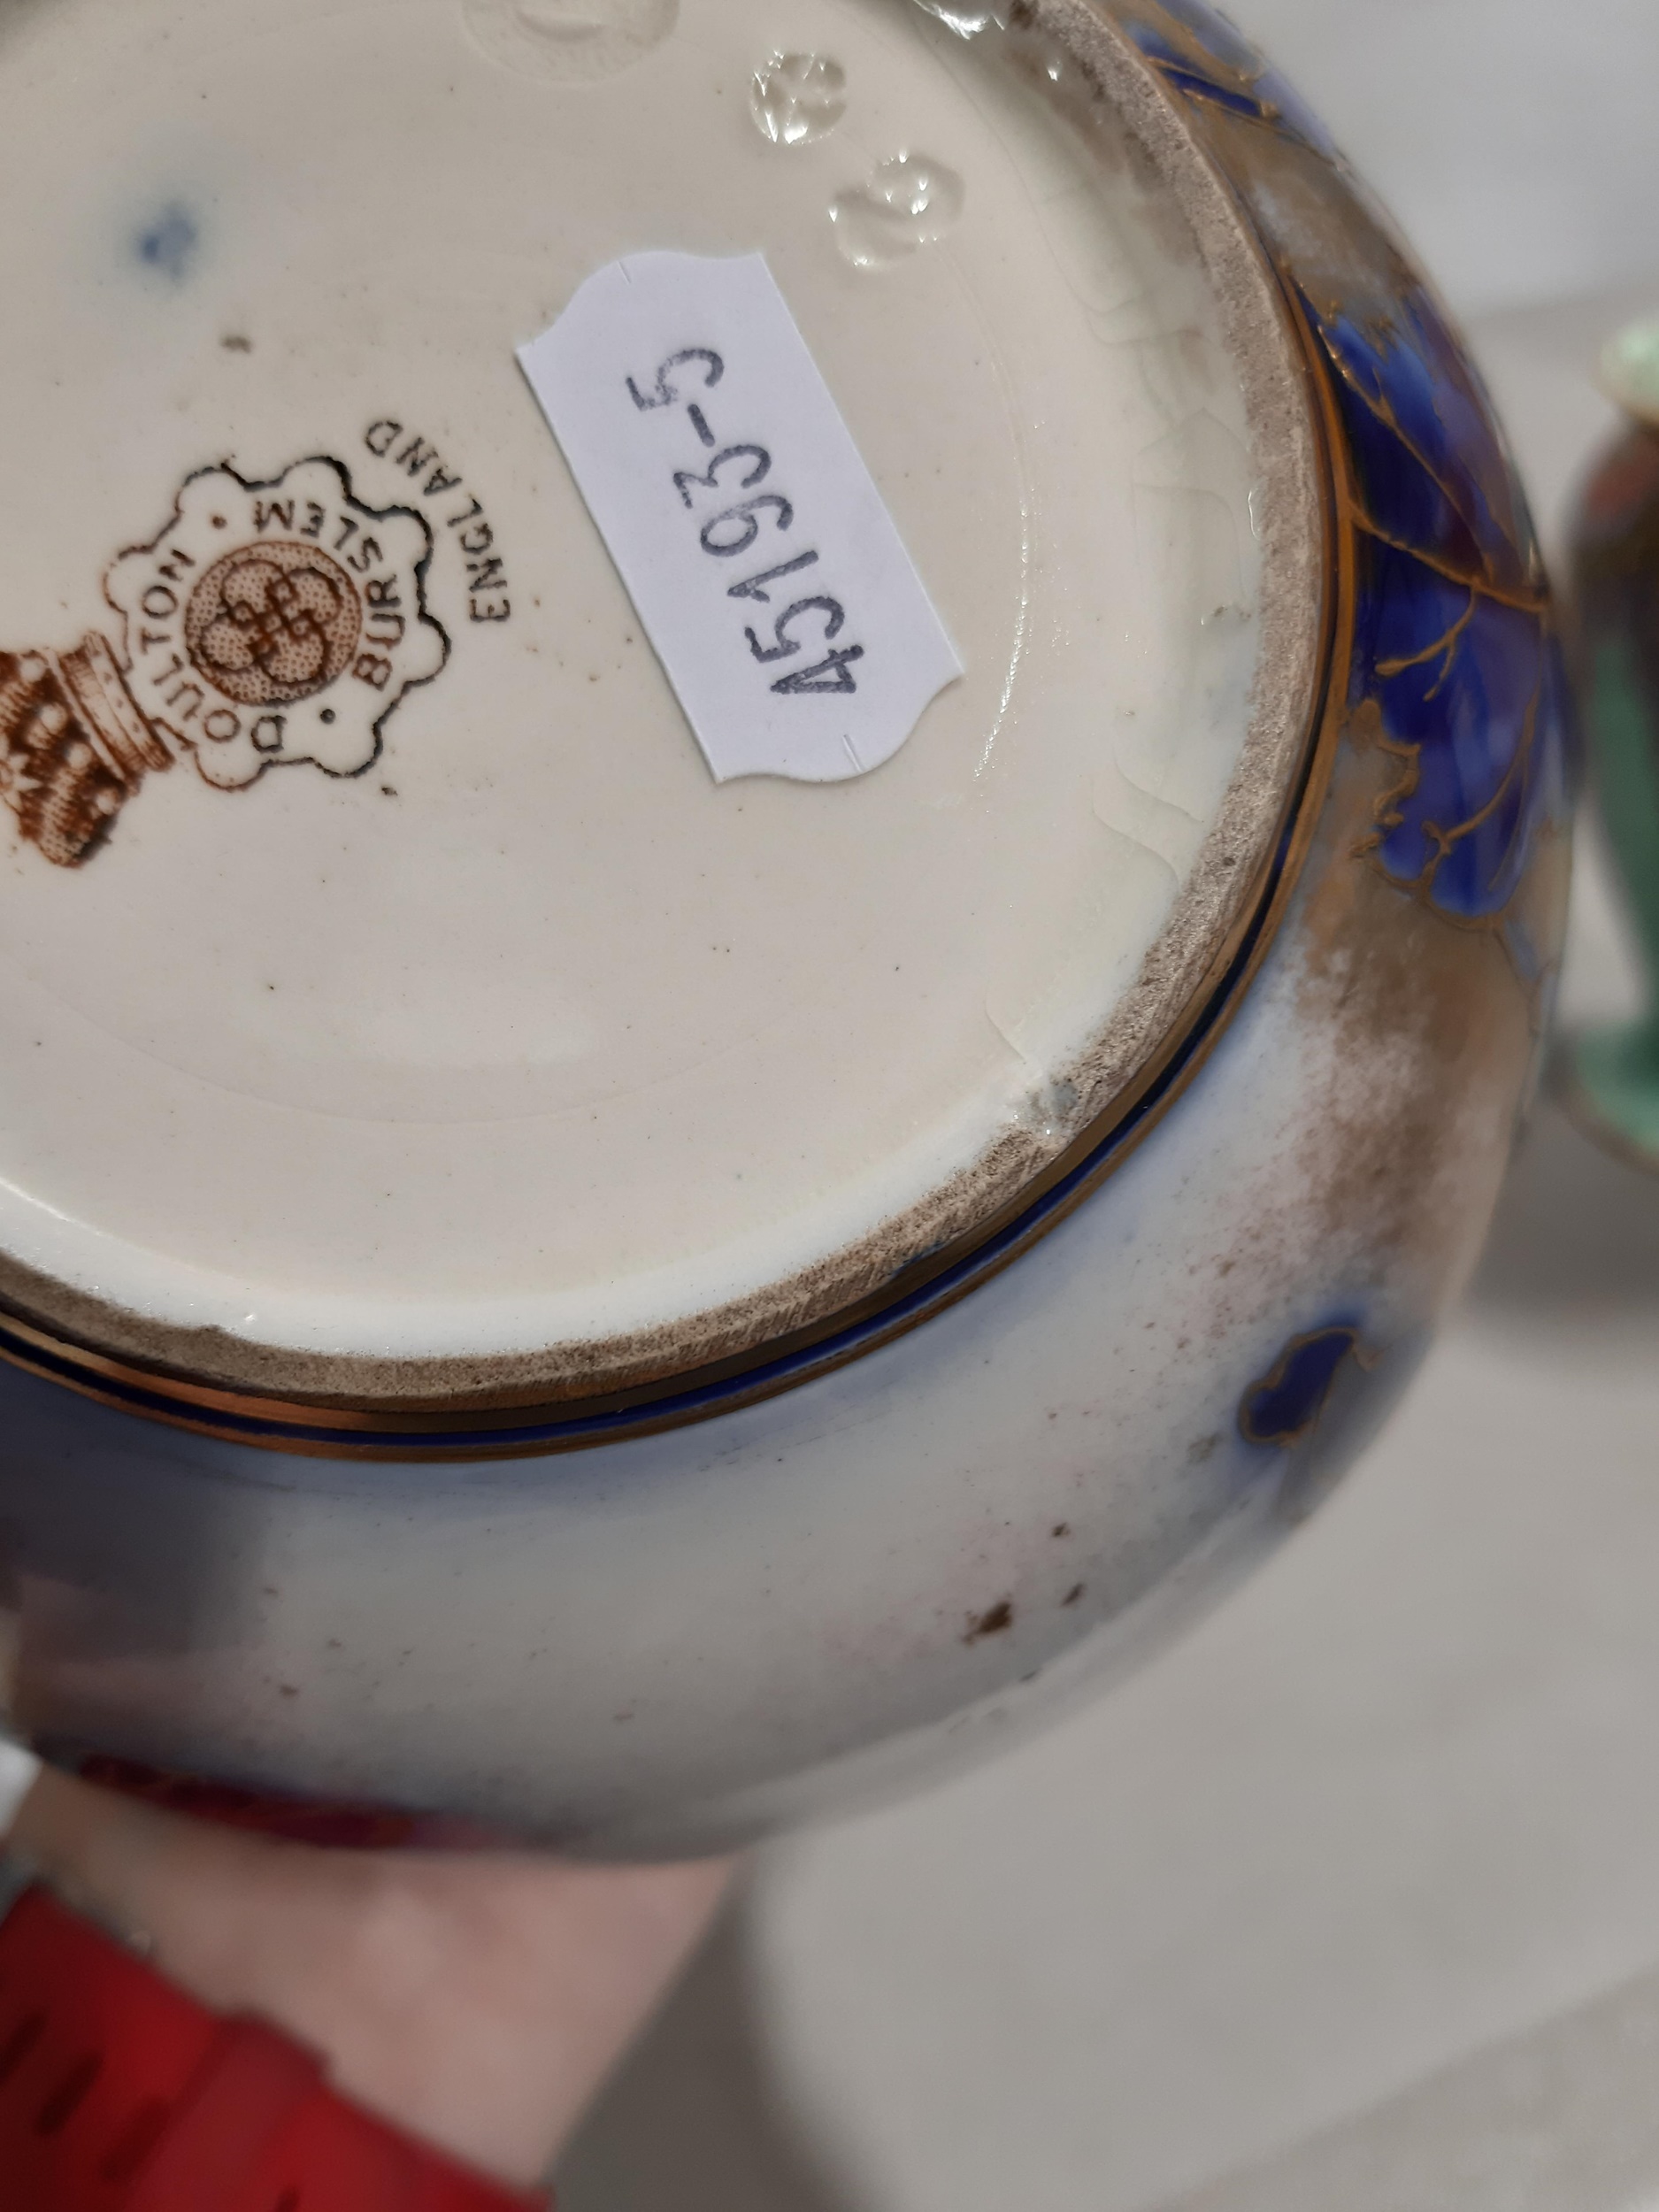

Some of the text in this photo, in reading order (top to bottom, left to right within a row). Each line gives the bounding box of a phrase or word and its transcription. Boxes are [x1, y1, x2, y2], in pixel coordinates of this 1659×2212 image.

[254, 499, 407, 691] BURSLEM
[364, 419, 511, 623] ENGLAND
[626, 348, 865, 695] 45193-5
[141, 549, 288, 753] DOULTON
